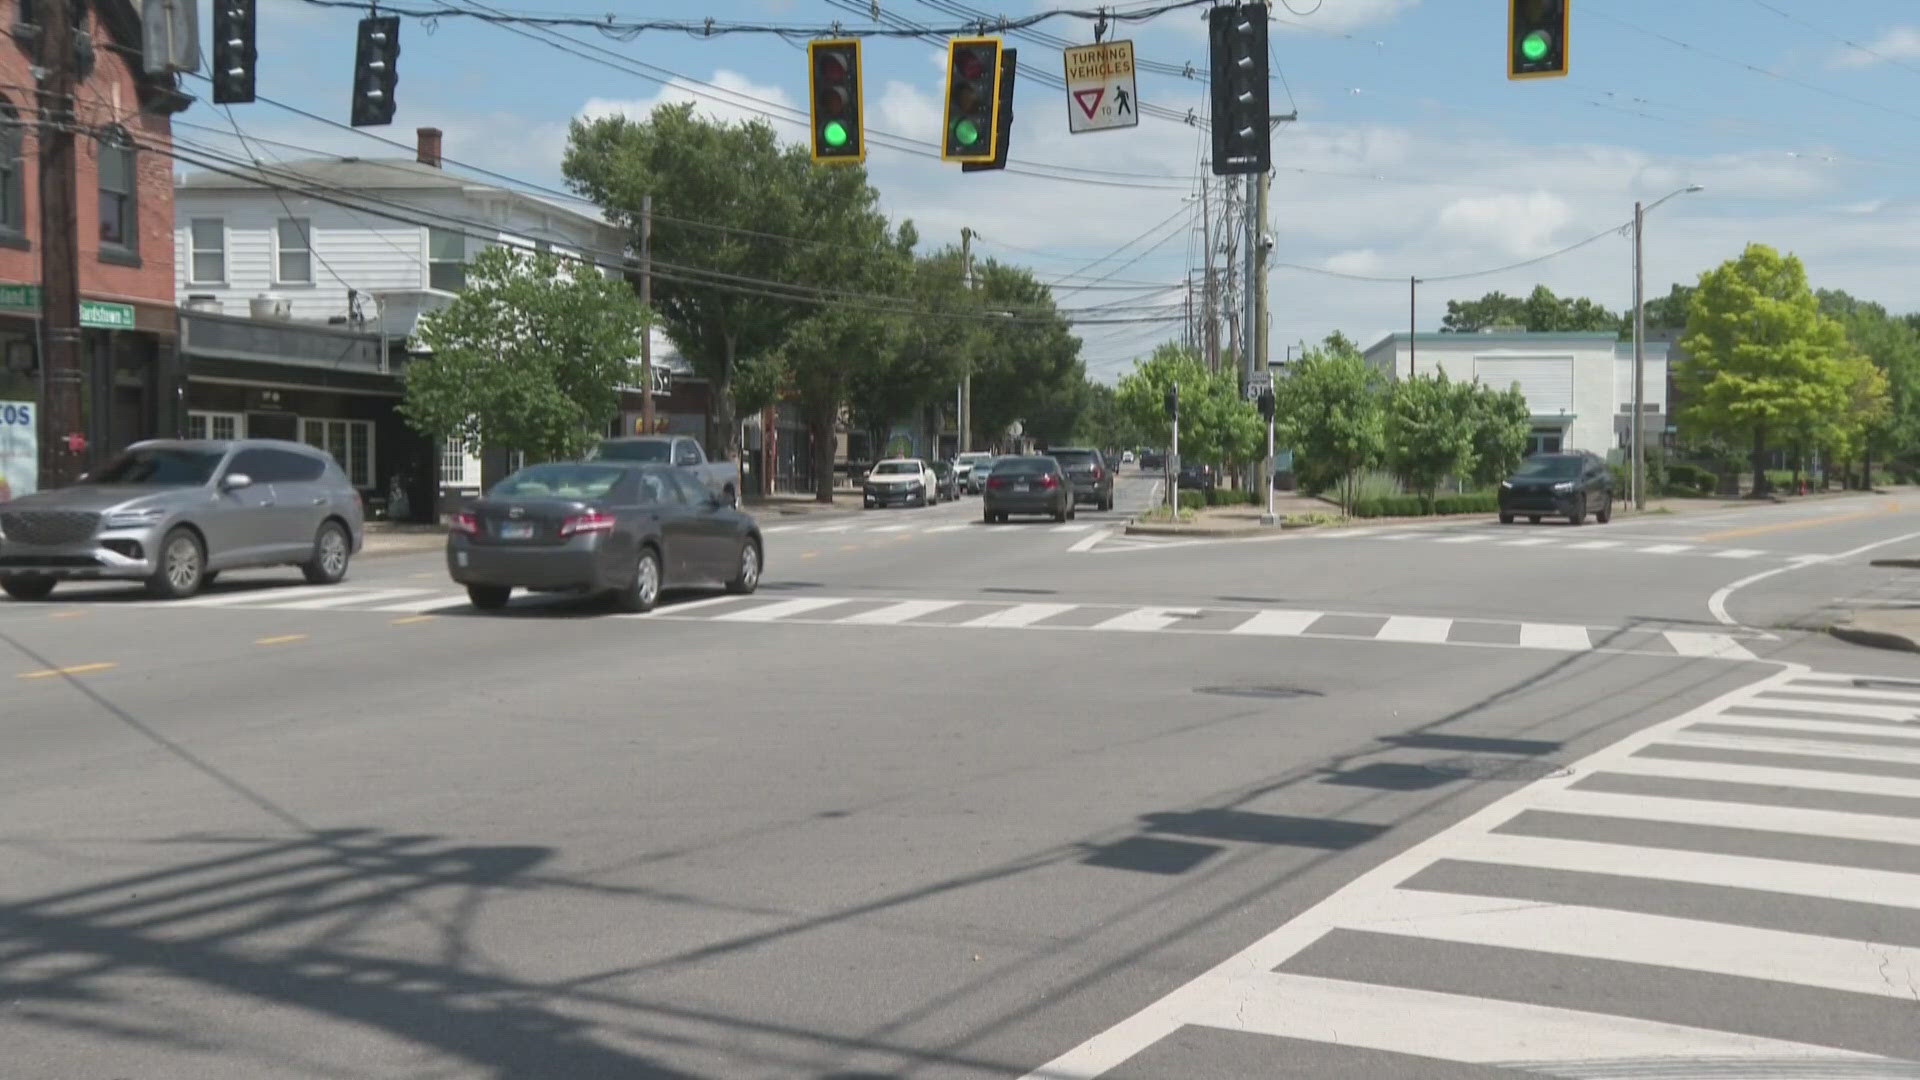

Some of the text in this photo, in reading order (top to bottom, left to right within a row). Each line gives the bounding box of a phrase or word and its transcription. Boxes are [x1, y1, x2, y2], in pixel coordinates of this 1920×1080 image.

[1072, 47, 1126, 65] TURNING
[1070, 61, 1131, 79] VEHICLES
[1102, 106, 1112, 116] TO
[0, 404, 30, 425] OS
